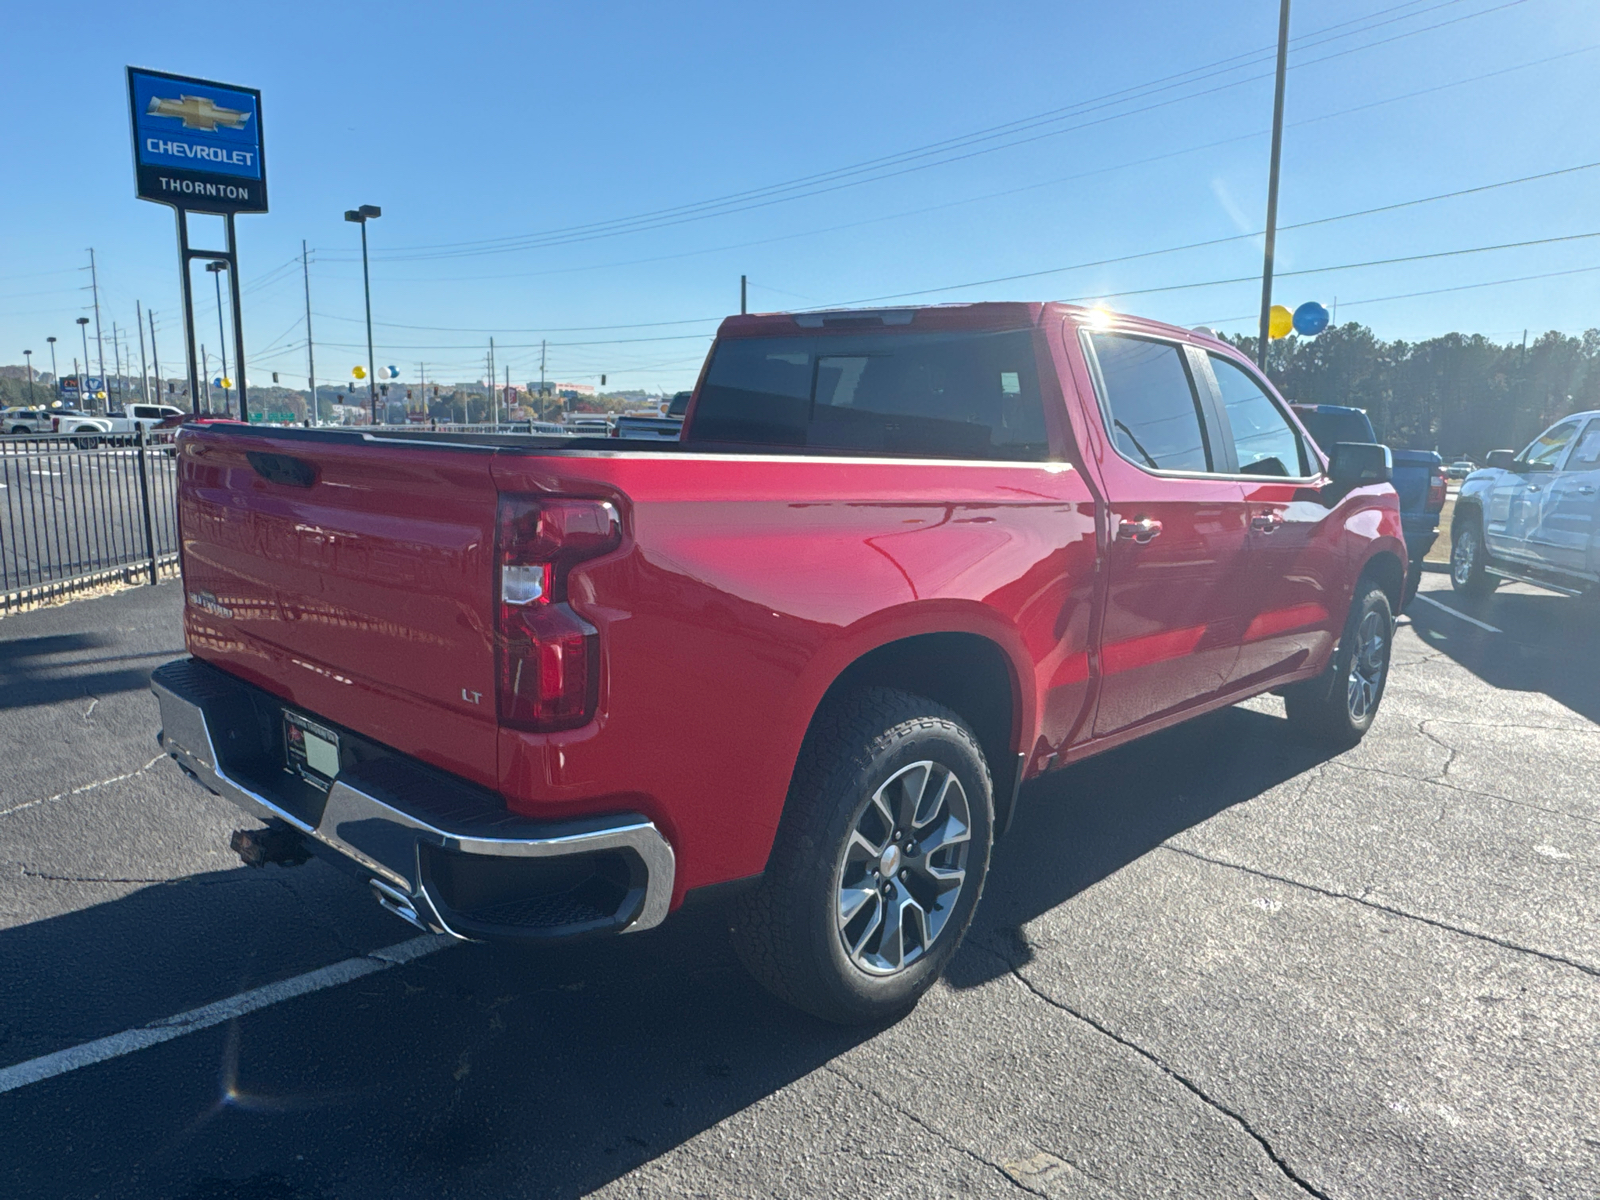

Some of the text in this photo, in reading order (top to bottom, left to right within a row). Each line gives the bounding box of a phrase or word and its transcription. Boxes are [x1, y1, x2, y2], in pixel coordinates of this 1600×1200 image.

[147, 138, 254, 166] CHEVROLET
[159, 177, 249, 200] THORNTON
[461, 688, 483, 705] LT
